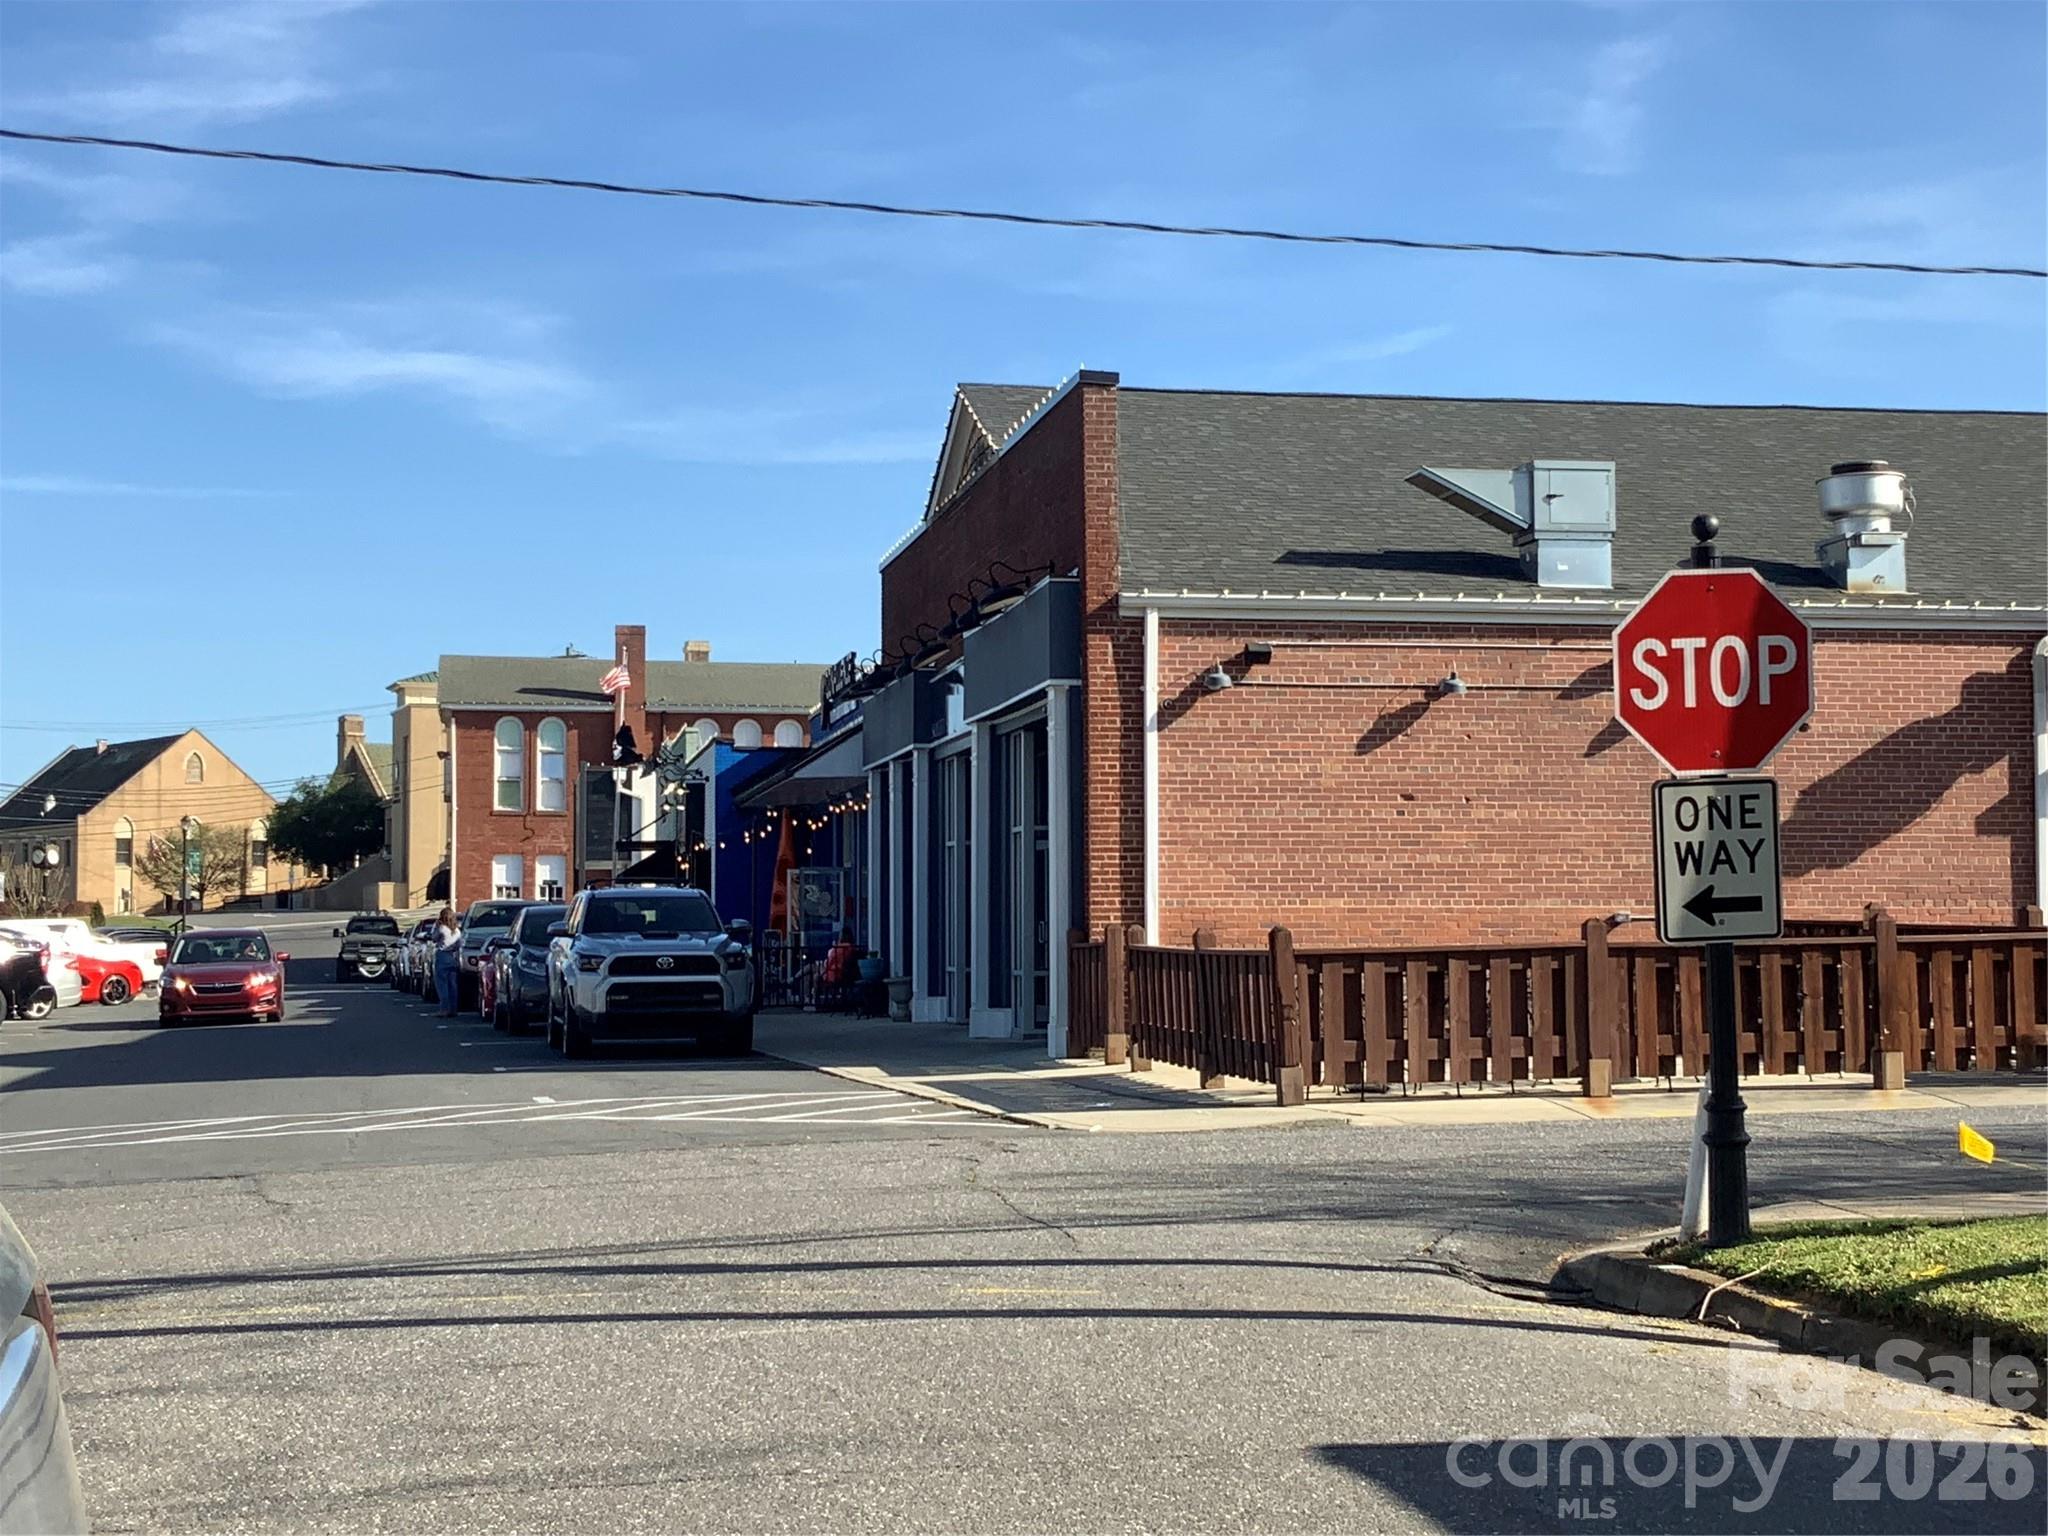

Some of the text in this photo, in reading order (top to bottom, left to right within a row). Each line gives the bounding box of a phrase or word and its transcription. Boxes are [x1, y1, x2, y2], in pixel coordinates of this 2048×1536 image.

[1629, 635, 1797, 711] STOP
[1674, 794, 1762, 832] ONE
[1674, 838, 1765, 877] WAY
